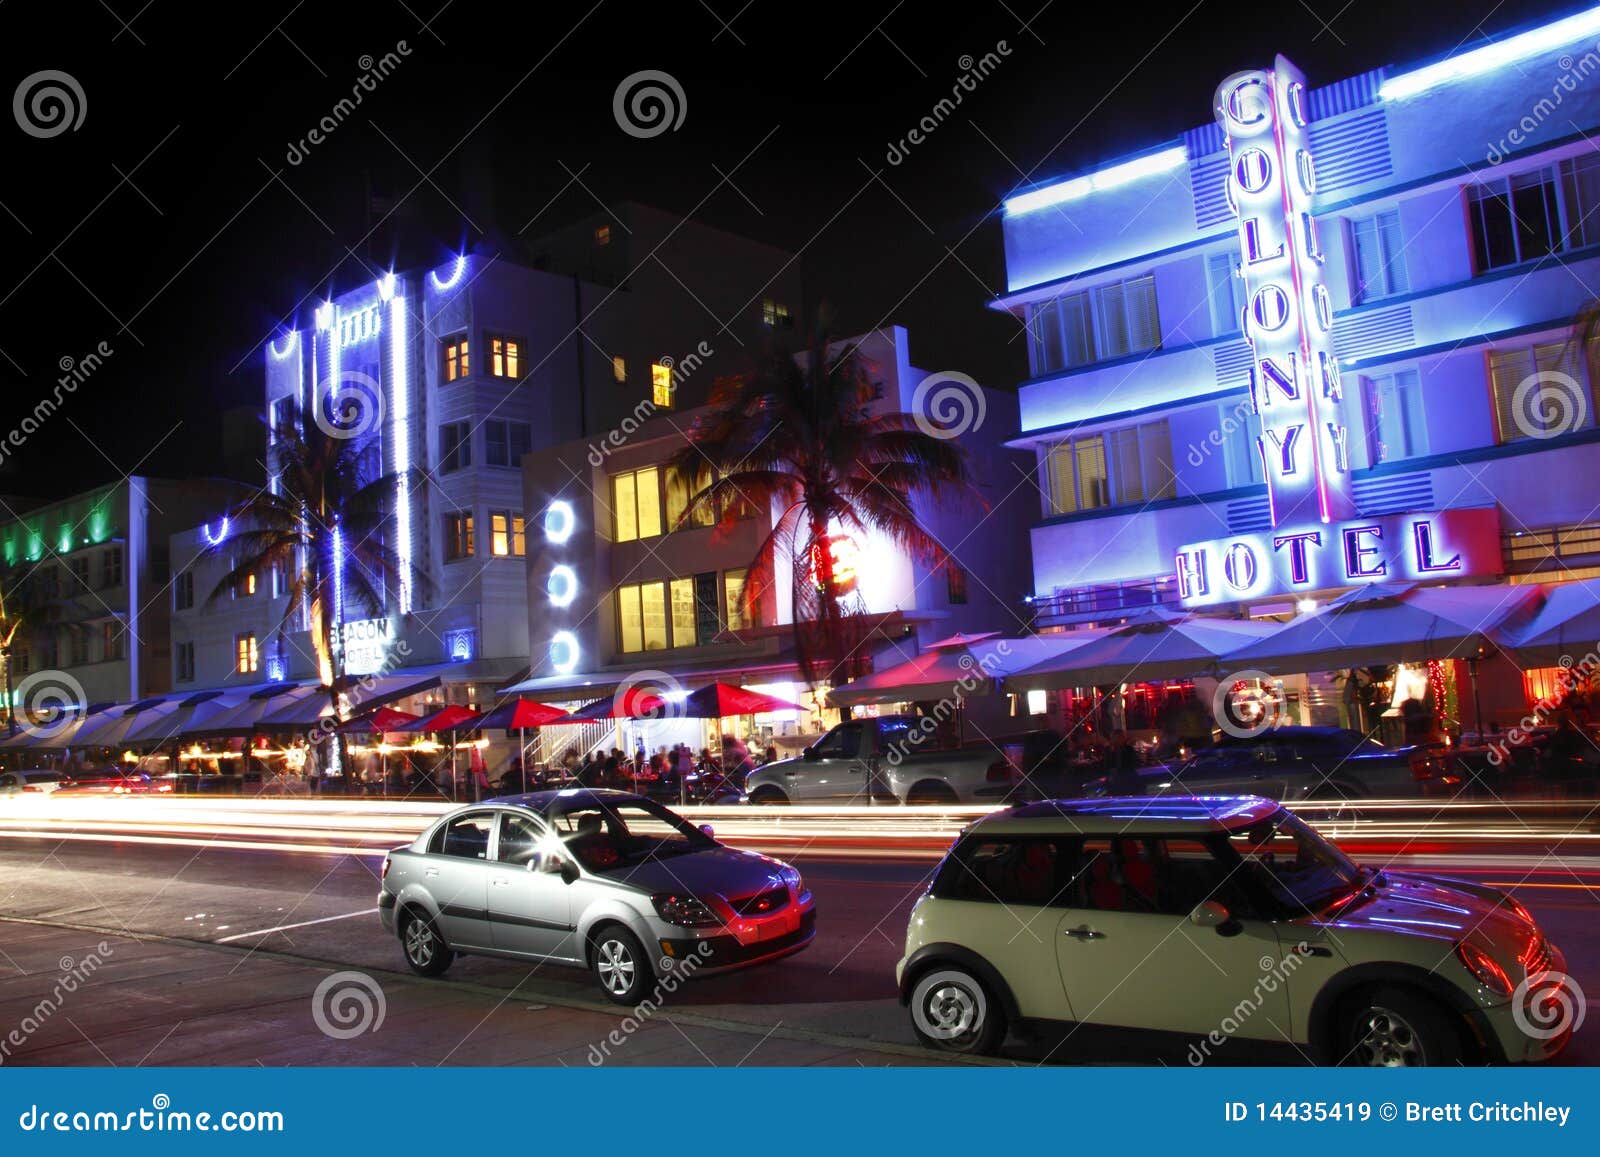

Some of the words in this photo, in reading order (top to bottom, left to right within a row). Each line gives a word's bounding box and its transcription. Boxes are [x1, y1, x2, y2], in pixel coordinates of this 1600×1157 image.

[1226, 78, 1304, 476] COLONY
[1287, 81, 1348, 474] COLONY
[1175, 520, 1461, 600] HOTEL
